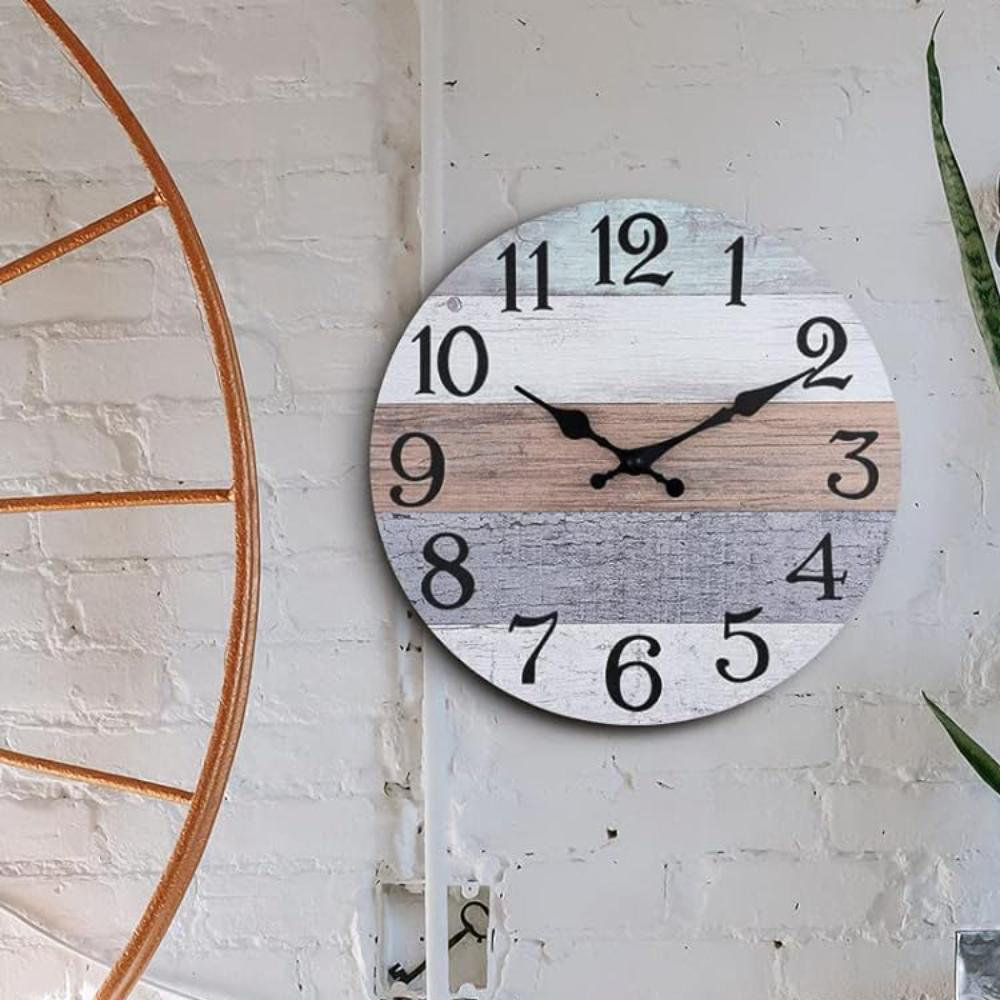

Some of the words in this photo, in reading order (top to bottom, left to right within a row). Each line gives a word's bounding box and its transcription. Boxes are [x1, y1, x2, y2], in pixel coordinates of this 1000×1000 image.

[497, 241, 553, 313] 11
[591, 212, 674, 286] 12
[724, 236, 746, 307] 1
[411, 325, 489, 397] 10
[796, 316, 854, 390] 2
[389, 431, 445, 508] 9
[827, 430, 879, 500] 3
[421, 532, 476, 611] 8
[785, 532, 848, 601] 4
[508, 610, 559, 685] 7
[605, 634, 662, 713] 6
[715, 606, 770, 683] 5
